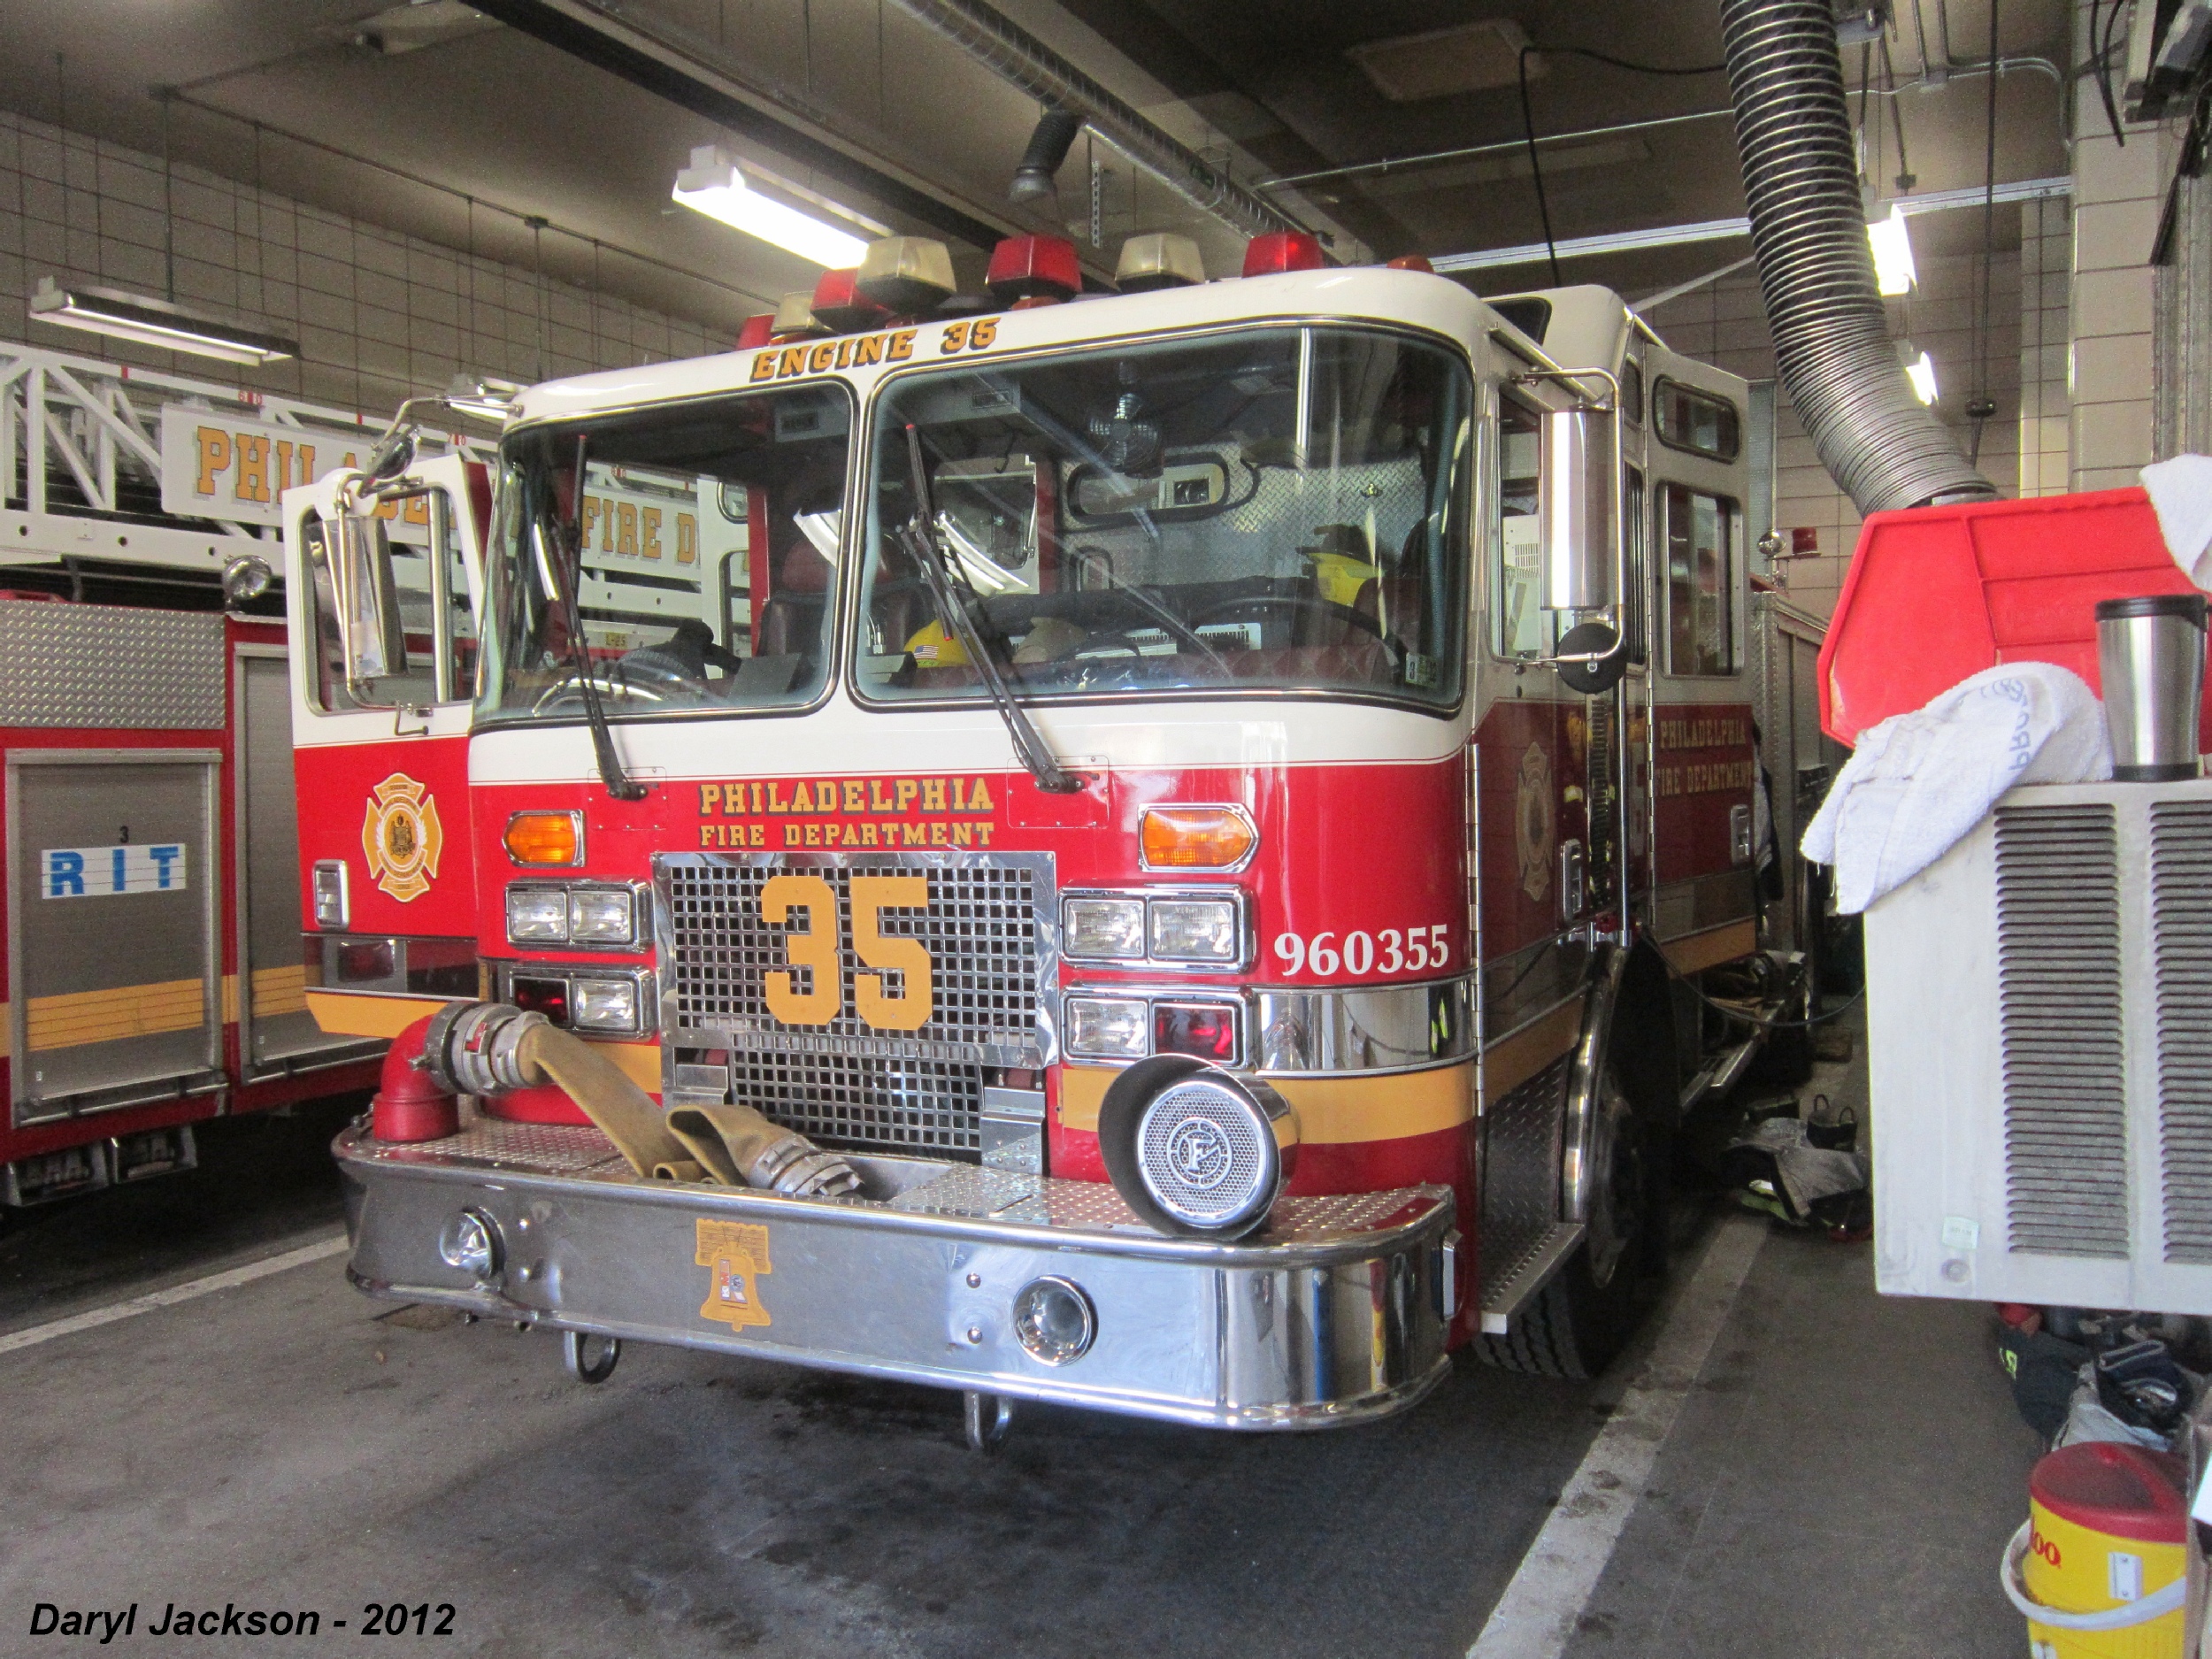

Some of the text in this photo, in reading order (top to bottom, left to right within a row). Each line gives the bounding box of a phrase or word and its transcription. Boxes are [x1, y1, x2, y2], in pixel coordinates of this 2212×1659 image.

[750, 317, 1001, 382] ENGINE 35
[581, 495, 700, 566] FIRE D
[1660, 719, 1747, 749] PHILADELPHIA
[699, 778, 995, 816] PHILADELPHIA
[119, 825, 130, 844] 3
[699, 822, 995, 847] FIRE DEPARTMENT
[760, 875, 933, 1031] 35
[1274, 924, 1449, 976] 960355
